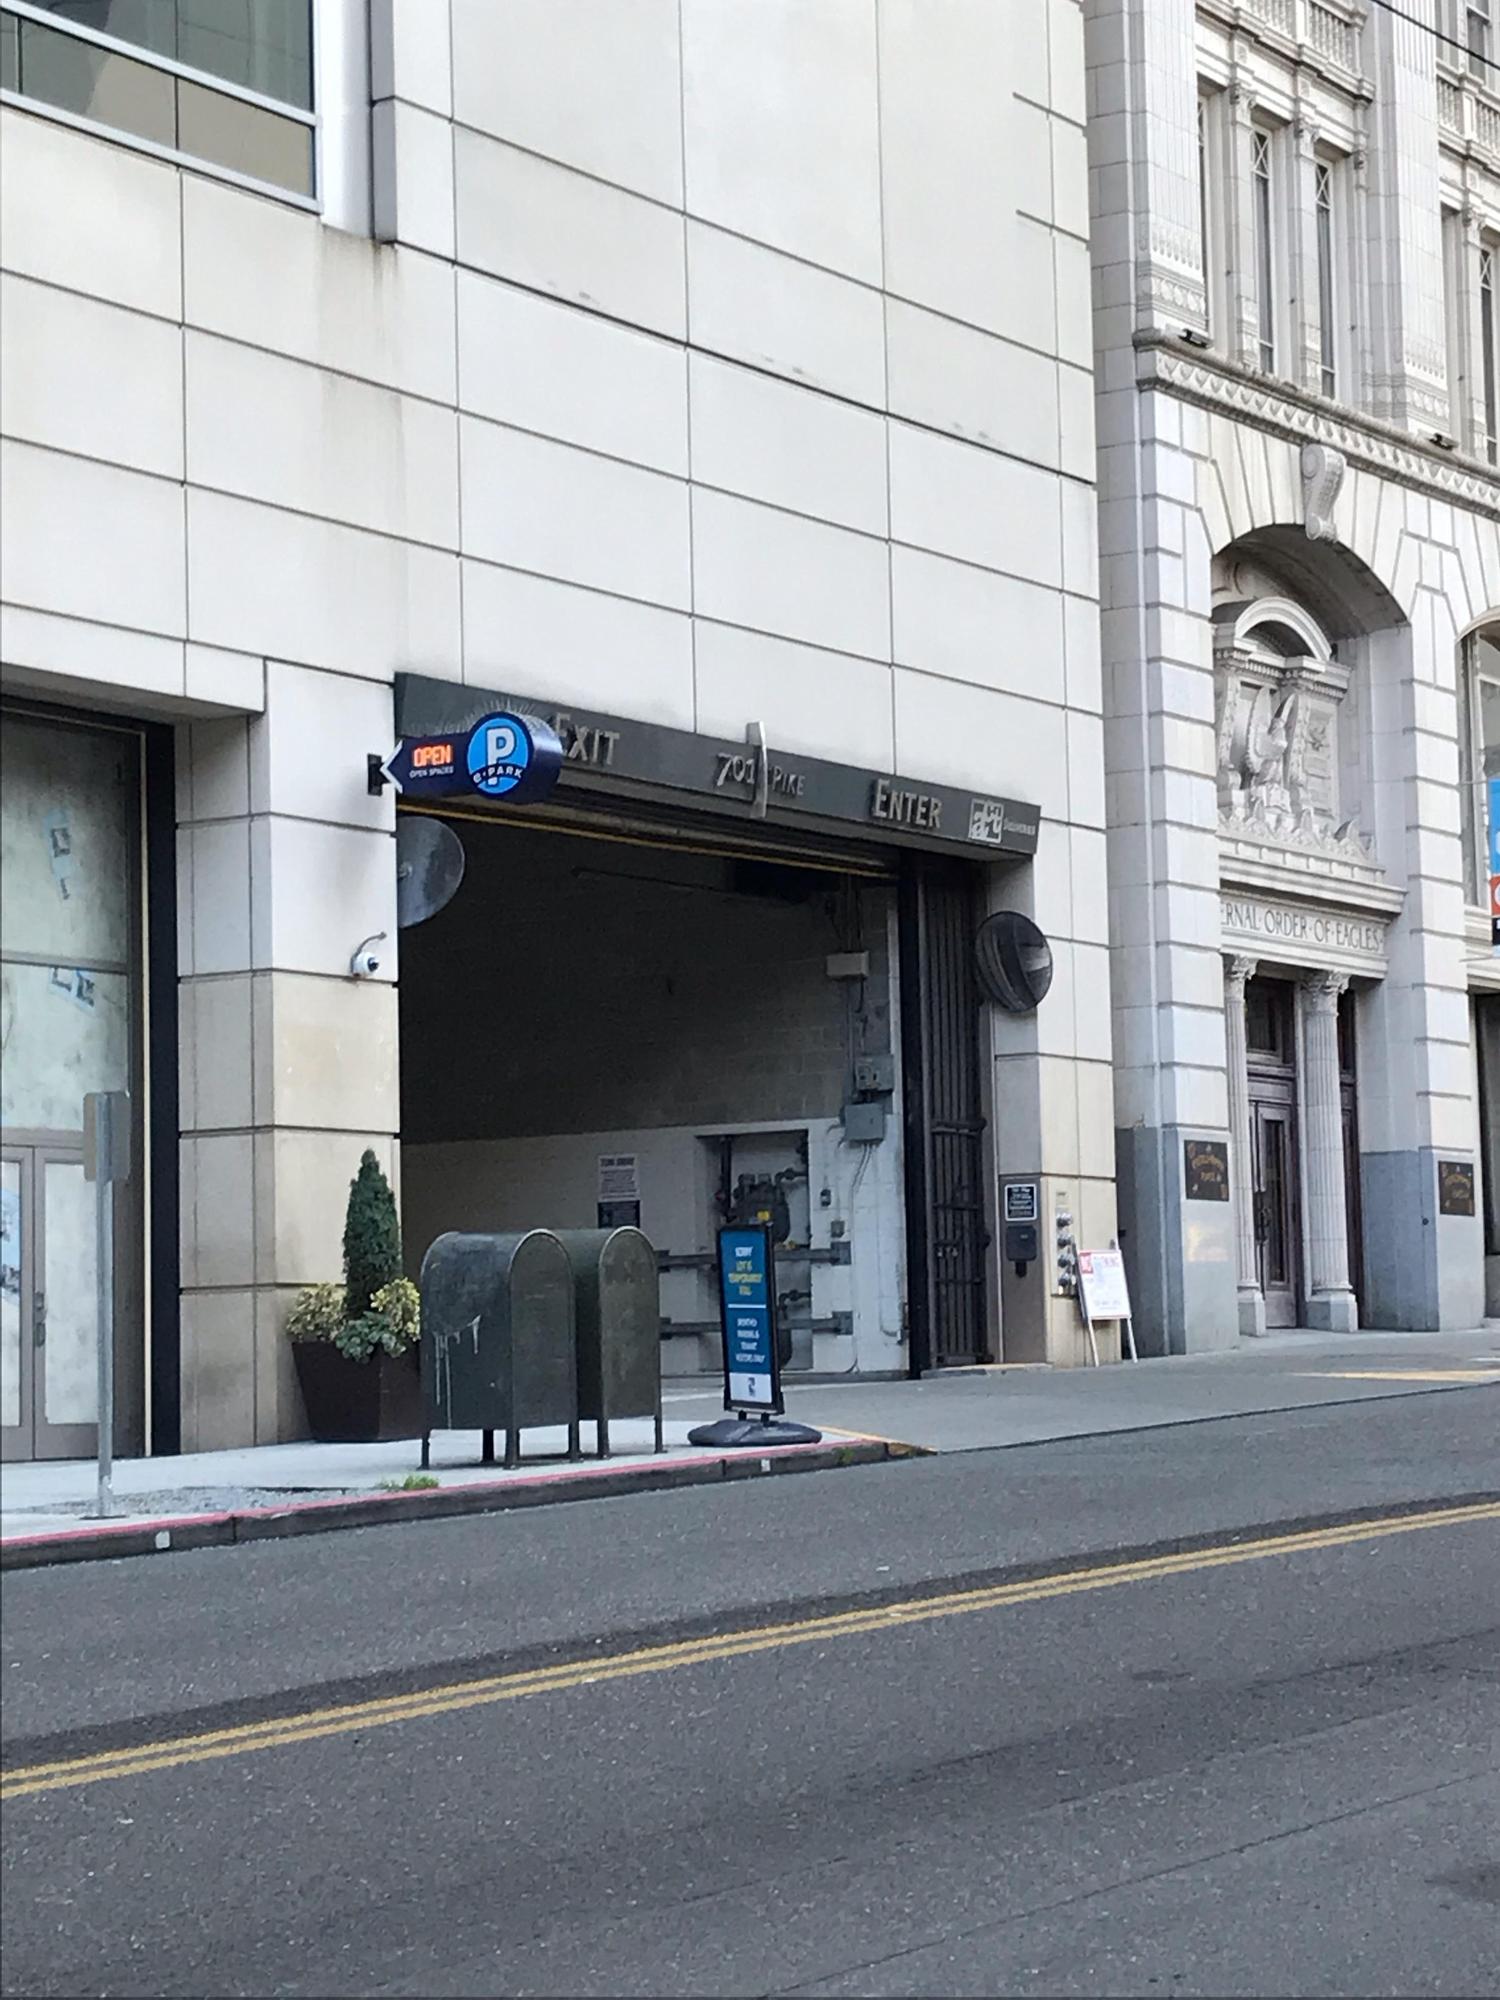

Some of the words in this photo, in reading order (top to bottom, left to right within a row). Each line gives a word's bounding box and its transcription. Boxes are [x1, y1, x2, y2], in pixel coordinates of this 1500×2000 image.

[413, 744, 452, 768] OPEN
[486, 727, 515, 785] P
[556, 711, 620, 766] EXIT
[409, 769, 428, 779] OPEN
[716, 752, 755, 787] 701
[772, 765, 806, 796] PIKE
[872, 778, 943, 829] ENTER
[1264, 909, 1308, 938] ORDER
[1313, 918, 1331, 944] OF
[1336, 923, 1380, 951] EAGLES
